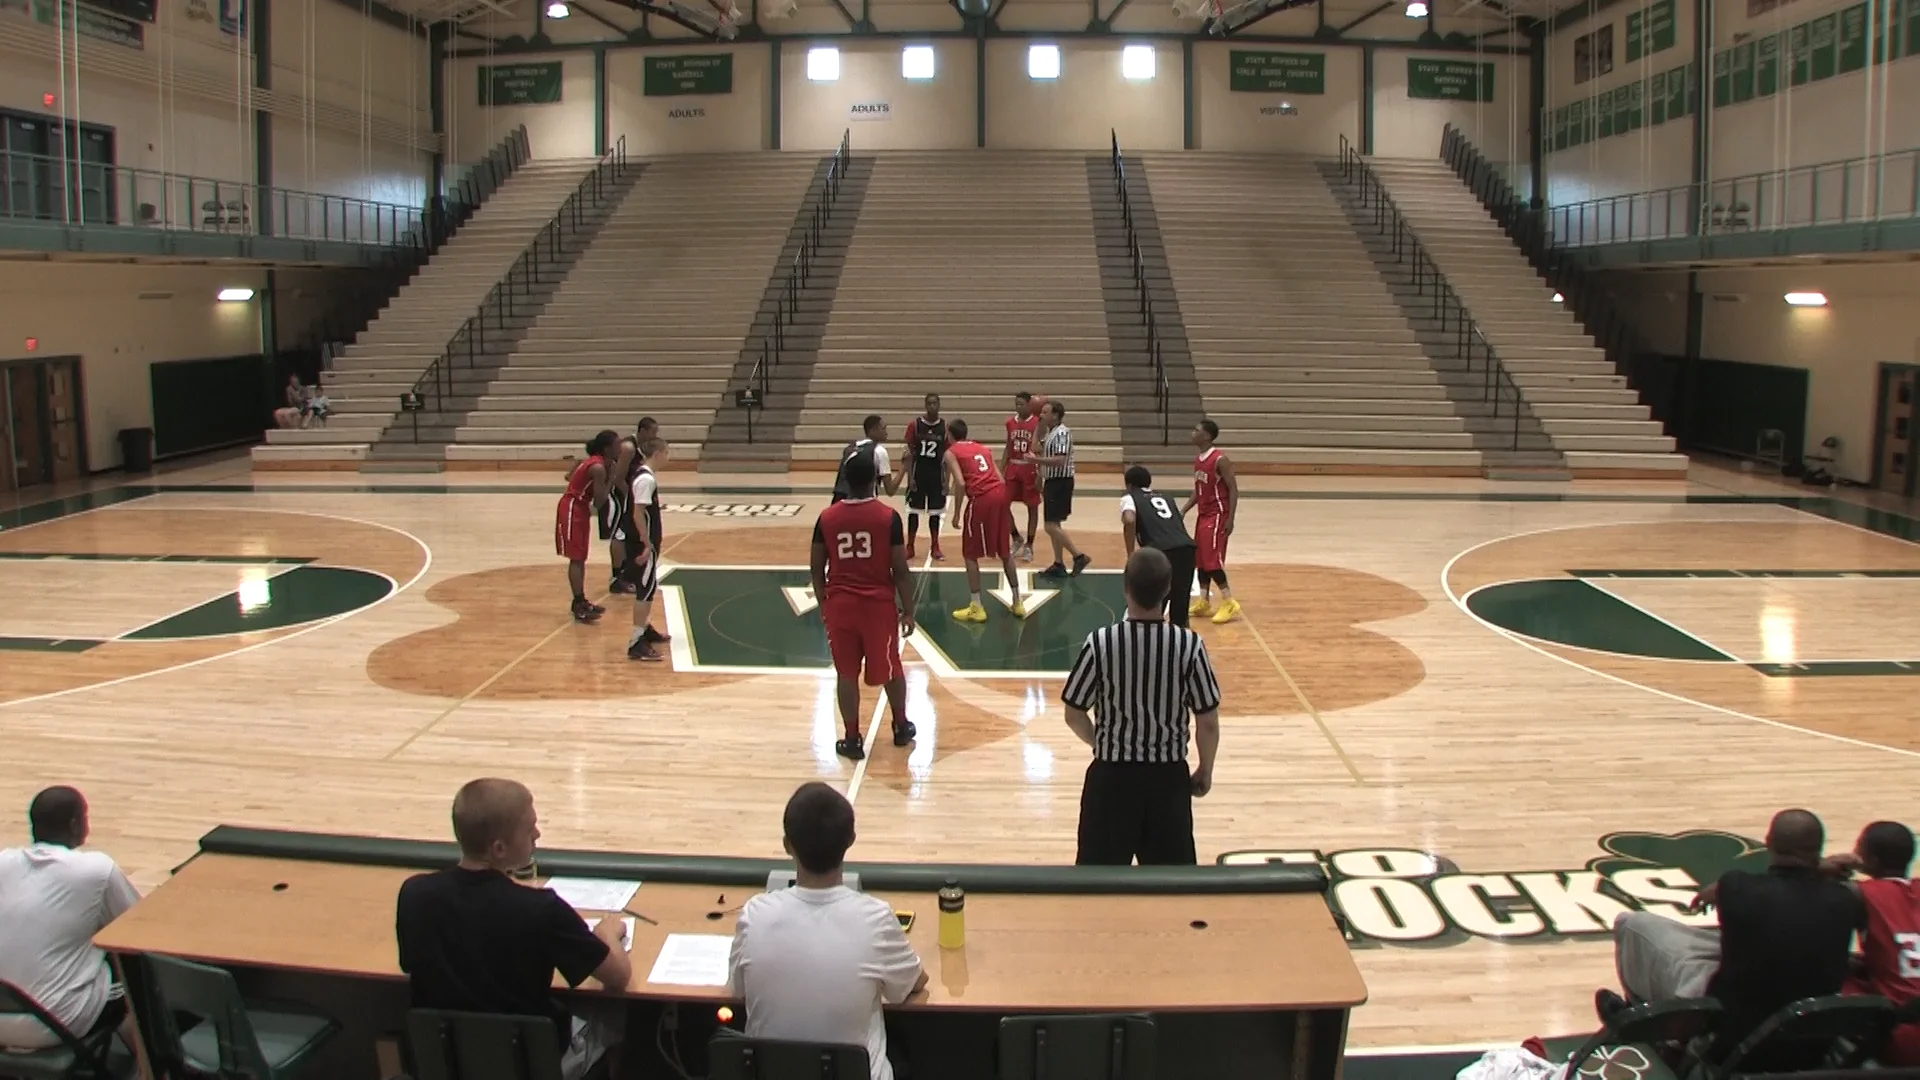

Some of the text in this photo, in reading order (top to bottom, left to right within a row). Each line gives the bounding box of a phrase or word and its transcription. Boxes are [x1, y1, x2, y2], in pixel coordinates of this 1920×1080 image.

[668, 108, 706, 118] ADULTS
[851, 103, 890, 113] ADULTS
[919, 440, 938, 458] 12
[973, 453, 989, 472] 3
[1150, 496, 1173, 519] 9
[836, 531, 873, 560] 23
